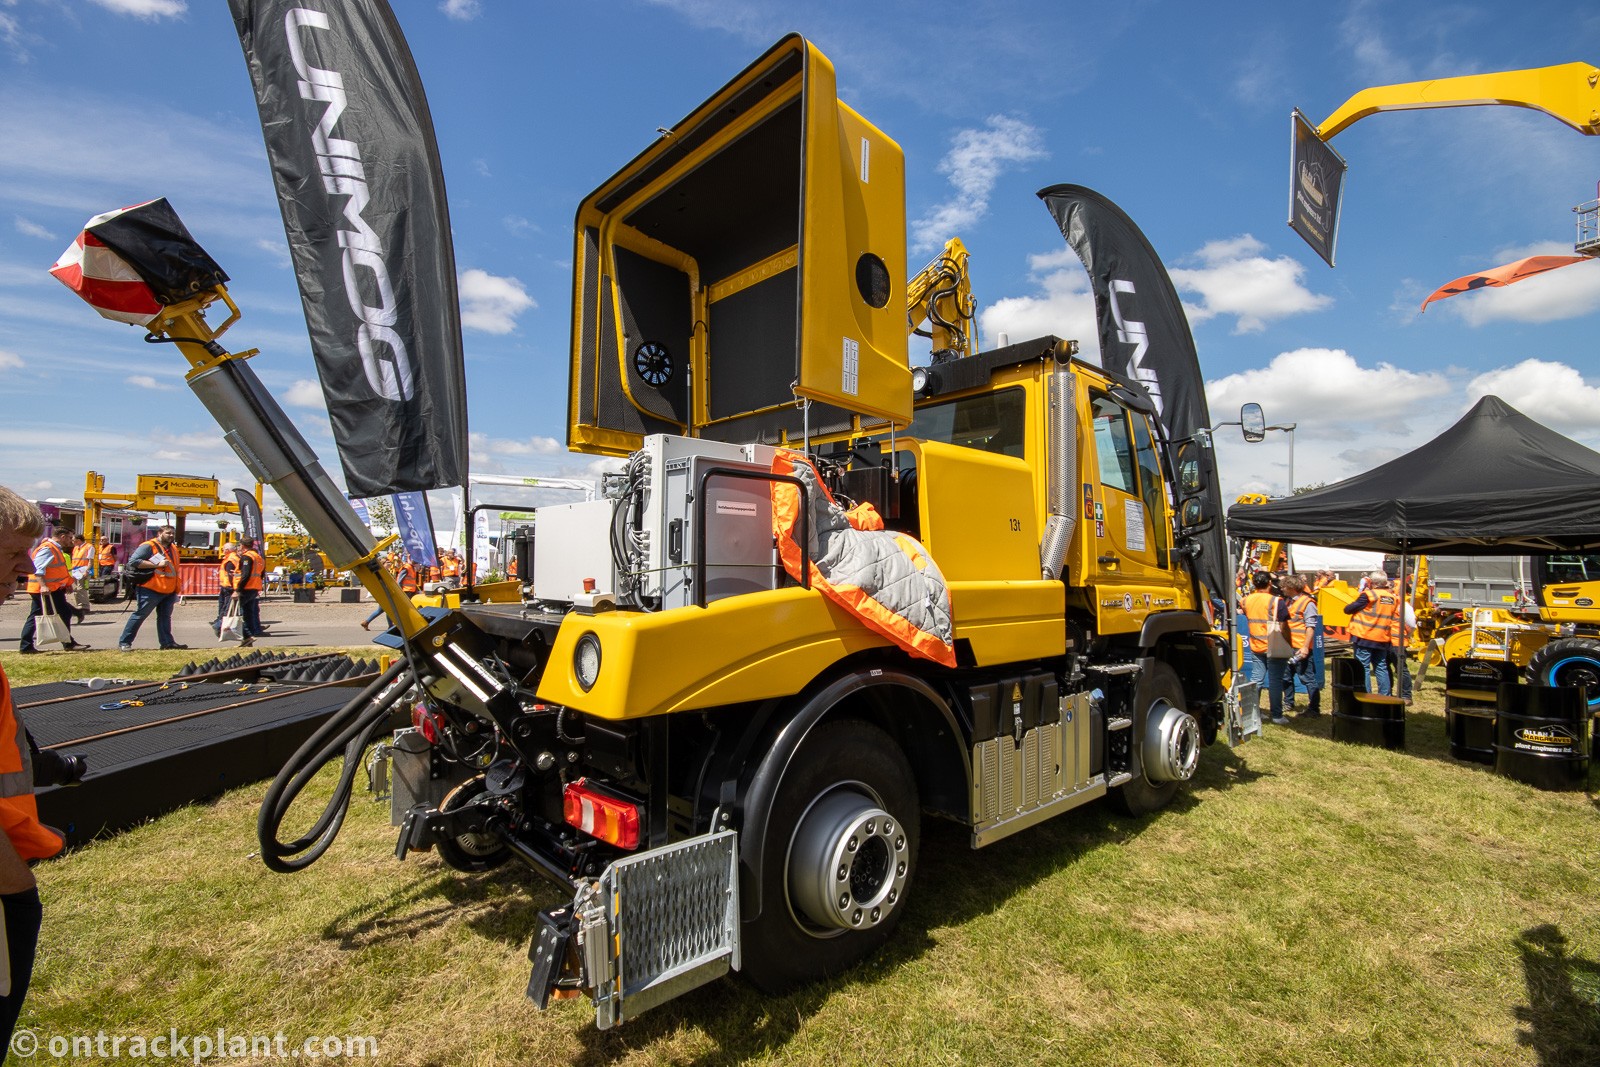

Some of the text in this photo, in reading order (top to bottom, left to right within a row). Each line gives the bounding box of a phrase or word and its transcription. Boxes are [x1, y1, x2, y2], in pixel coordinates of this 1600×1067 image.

[285, 7, 414, 402] UNIMOG
[170, 481, 209, 489] McCulloch
[1009, 518, 1021, 532] 13t
[1523, 729, 1549, 738] ALLAN
[1523, 734, 1572, 744] HARGREAVES
[1515, 742, 1531, 750] plant
[1531, 745, 1562, 753] engineers
